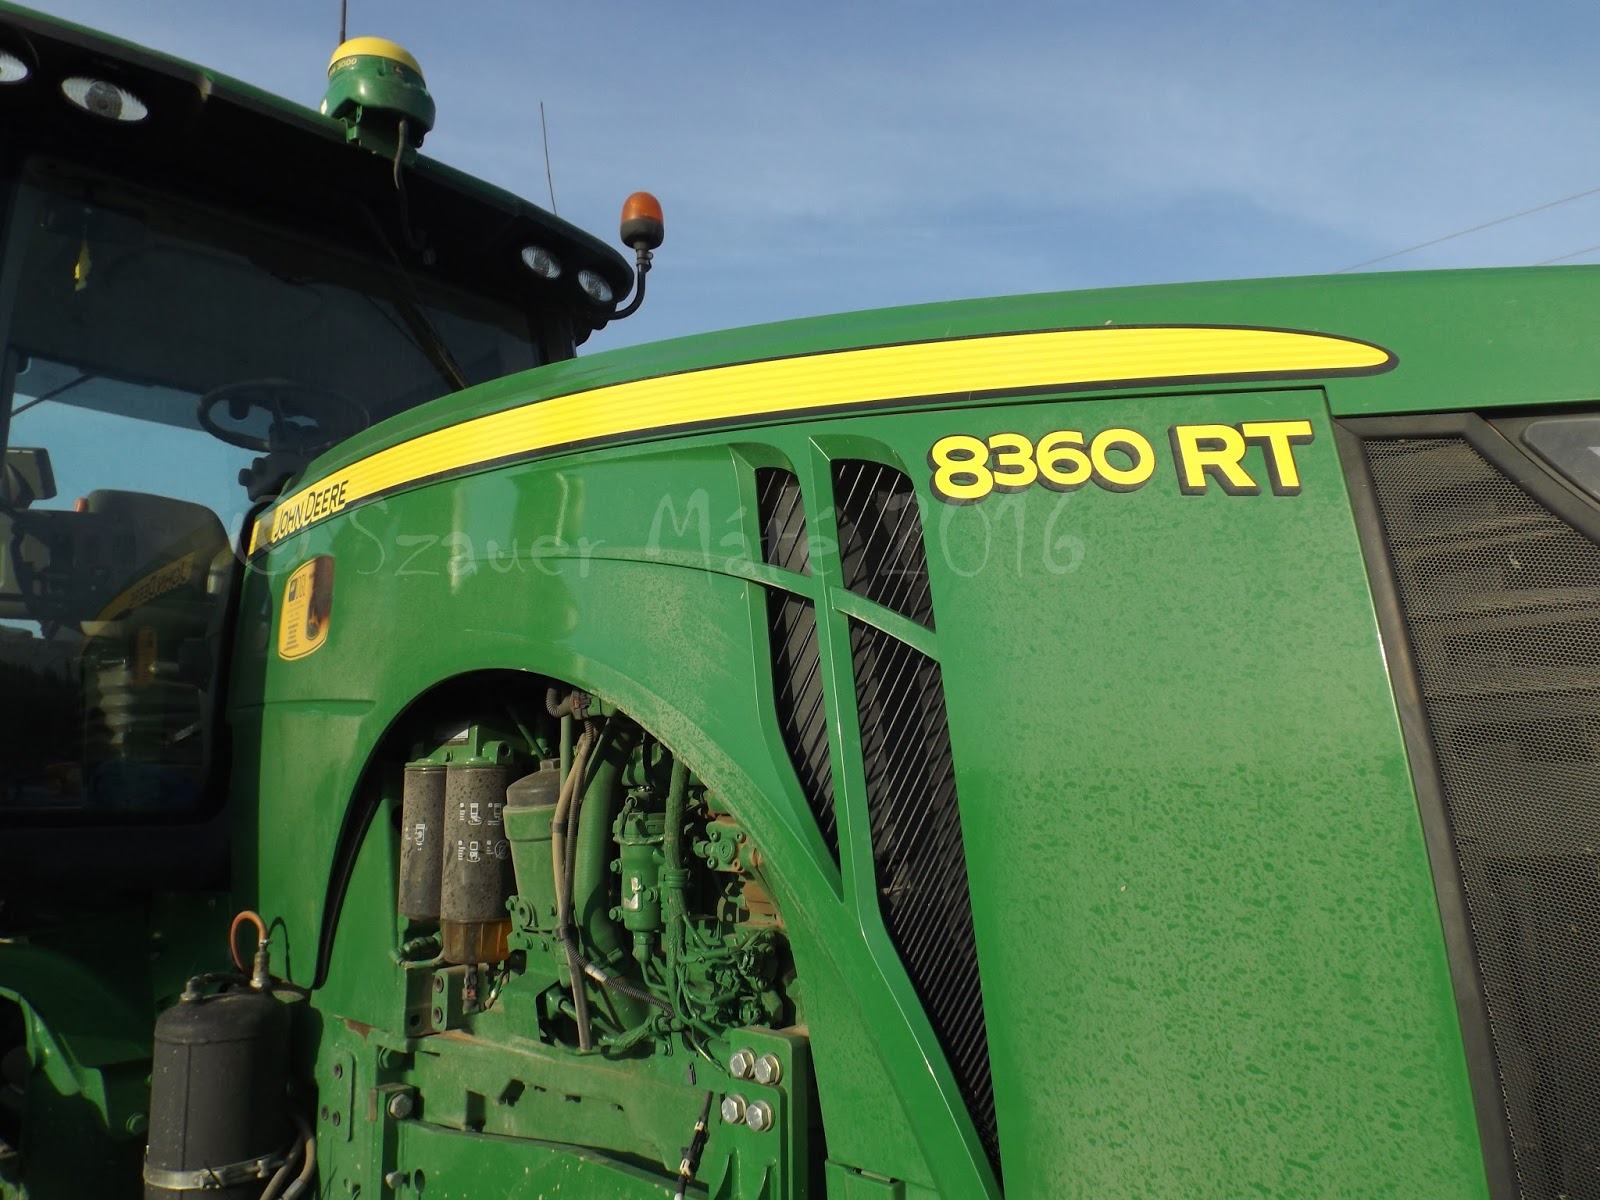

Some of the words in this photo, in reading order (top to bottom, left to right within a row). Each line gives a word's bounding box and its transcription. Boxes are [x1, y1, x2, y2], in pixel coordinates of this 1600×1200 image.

[927, 426, 1157, 505] 8360
[1168, 419, 1315, 497] RT
[274, 504, 305, 539] JOHN
[304, 479, 349, 521] DEERE
